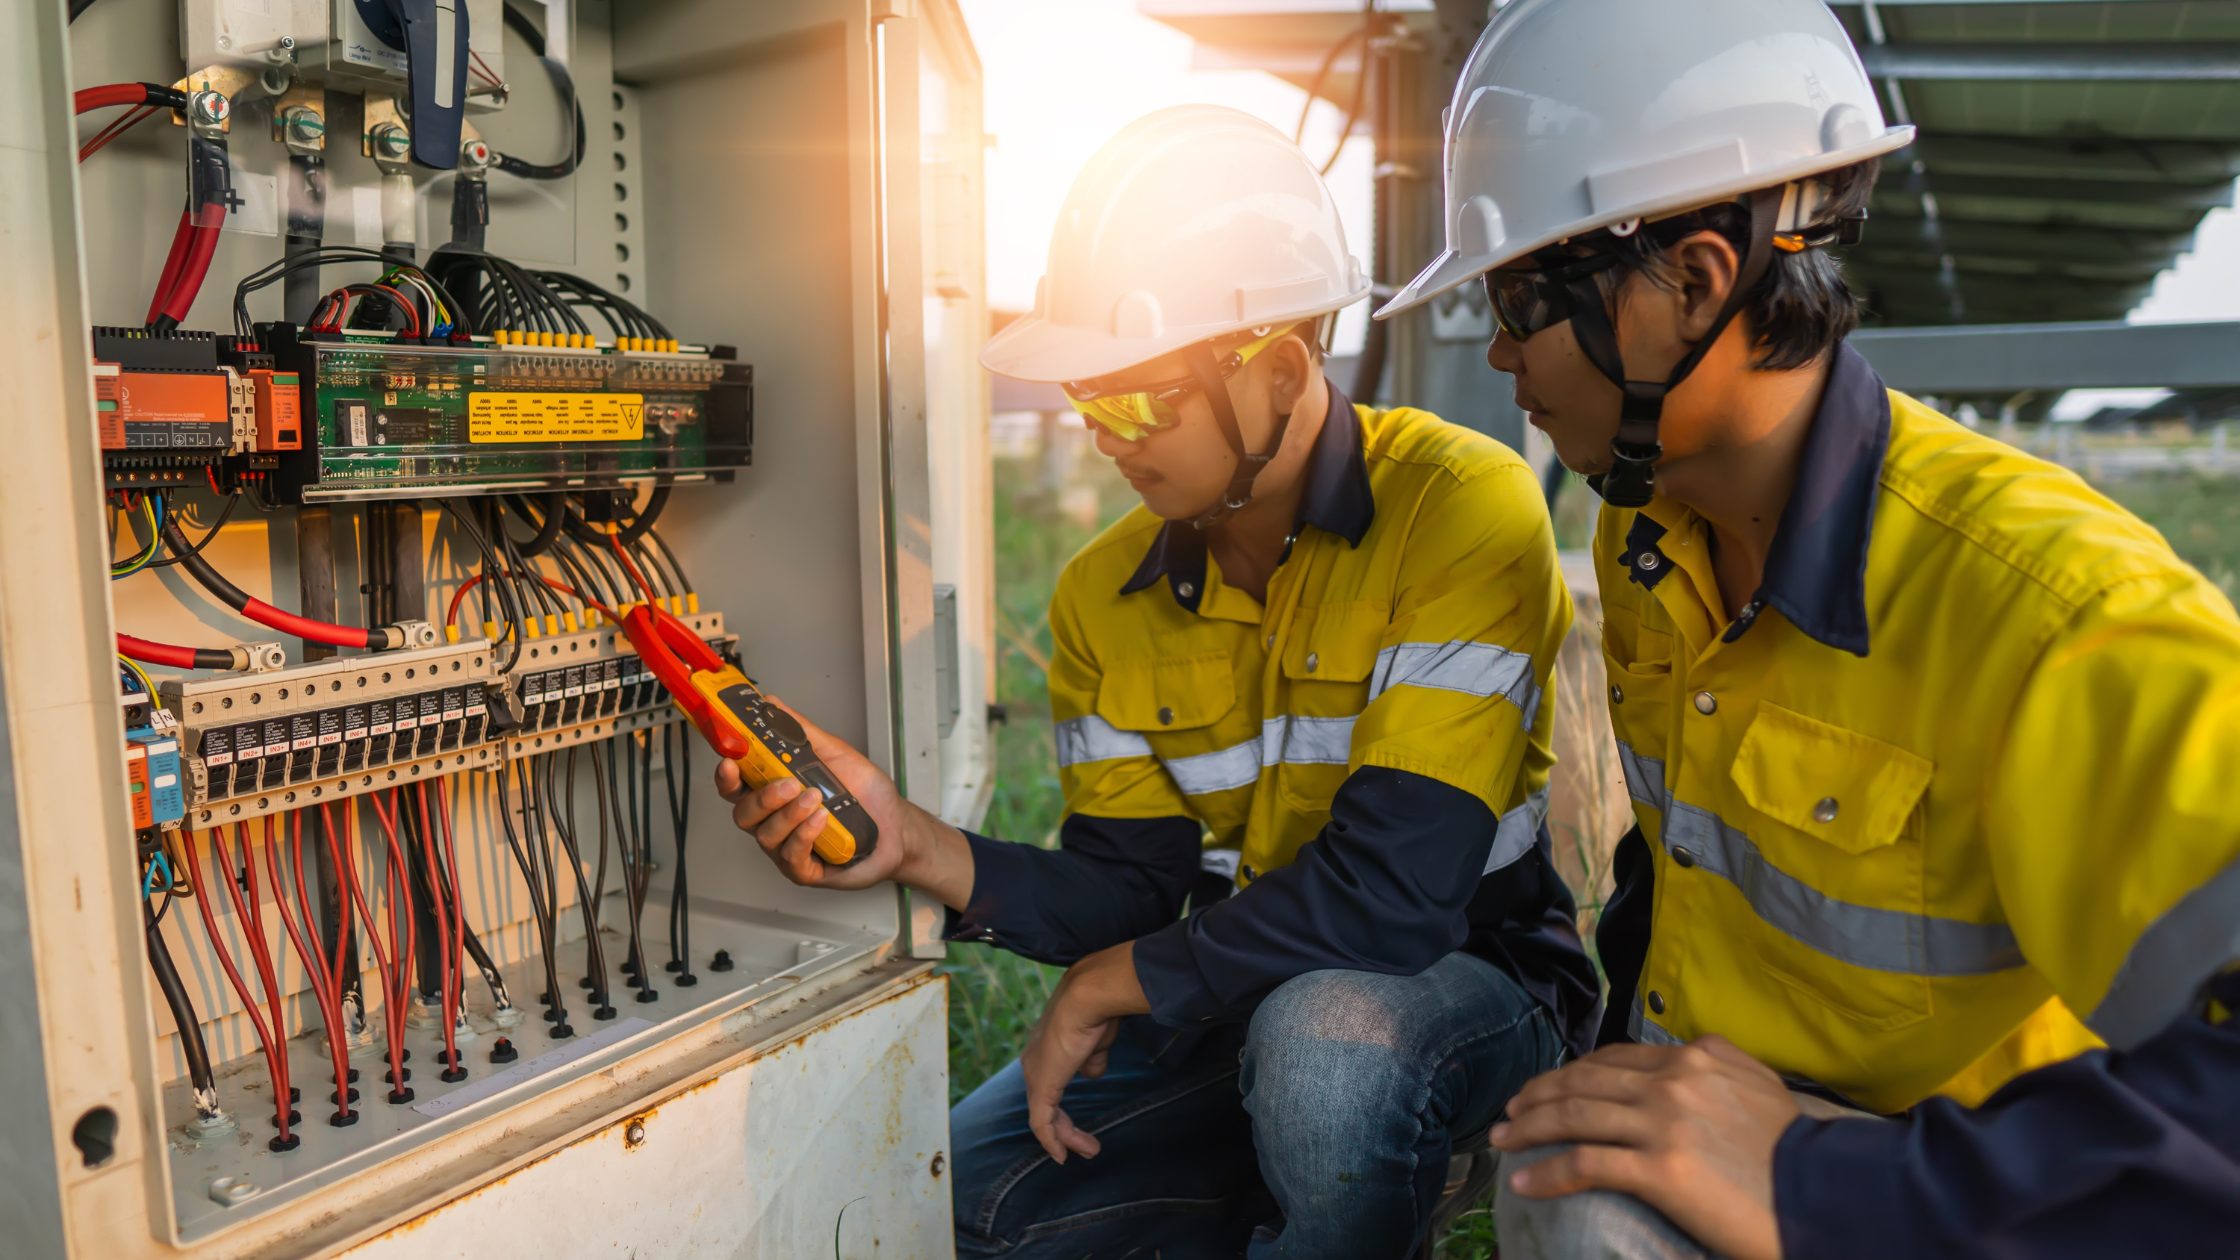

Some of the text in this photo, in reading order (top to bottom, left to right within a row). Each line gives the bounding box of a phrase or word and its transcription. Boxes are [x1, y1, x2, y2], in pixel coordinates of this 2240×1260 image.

[151, 716, 161, 725] L
[162, 713, 174, 722] N
[349, 730, 364, 738] IN6+
[297, 740, 312, 748] IN4+
[243, 750, 258, 758] IN2+
[212, 756, 228, 764] IN1+
